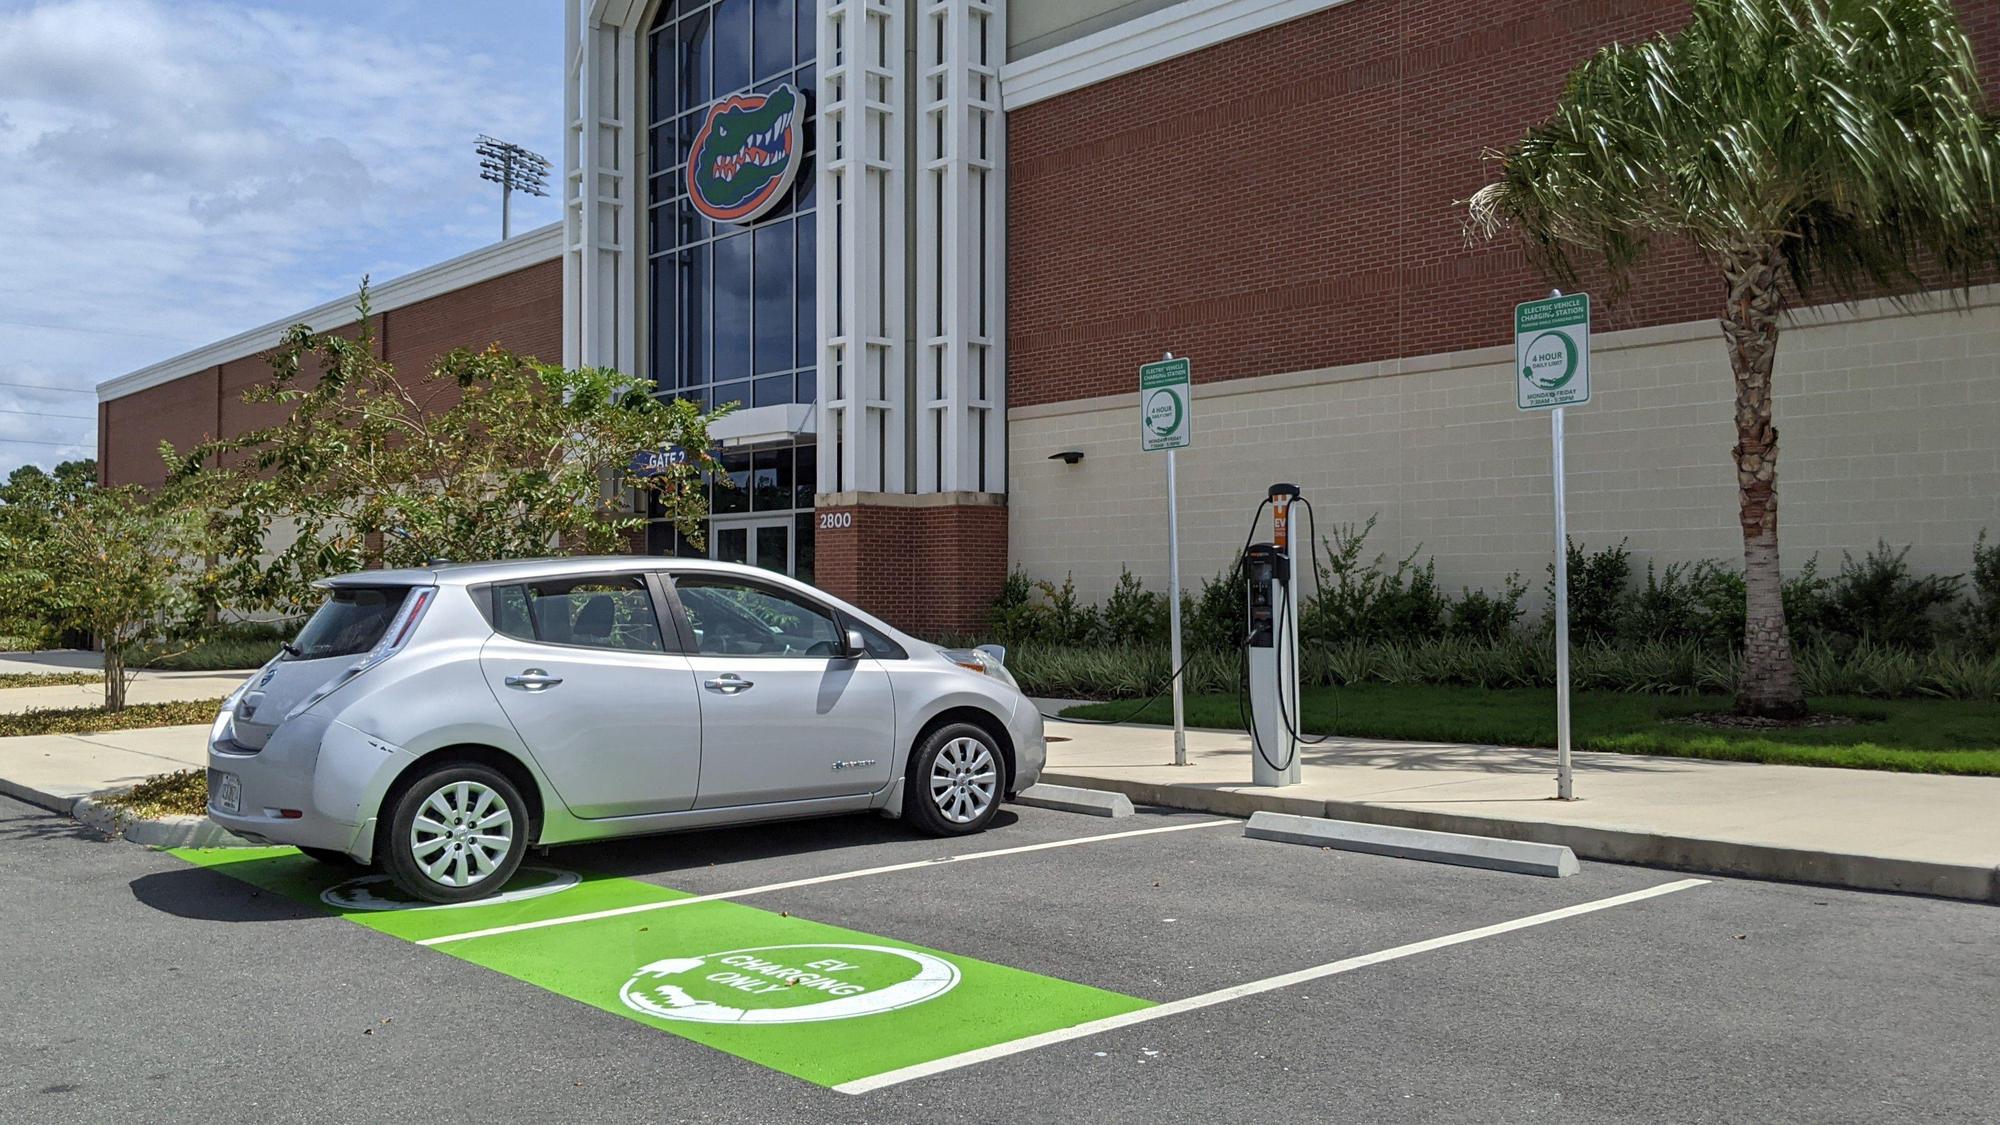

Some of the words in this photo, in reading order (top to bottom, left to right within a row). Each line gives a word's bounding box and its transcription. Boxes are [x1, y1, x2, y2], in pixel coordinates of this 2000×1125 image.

[1521, 311, 1555, 322] CHARGING
[1556, 306, 1584, 317] STATION
[1524, 304, 1553, 314] ELECTRIC
[1554, 299, 1580, 309] VEHICLE
[1532, 353, 1538, 362] 4
[1539, 351, 1563, 362] HOUR
[1156, 405, 1173, 413] HOUR
[649, 451, 677, 468] GATE
[819, 512, 852, 529] 2800
[1275, 518, 1286, 527] EV
[805, 958, 860, 973] EV
[706, 971, 789, 995] ONLY
[721, 955, 865, 997] CHARGING
